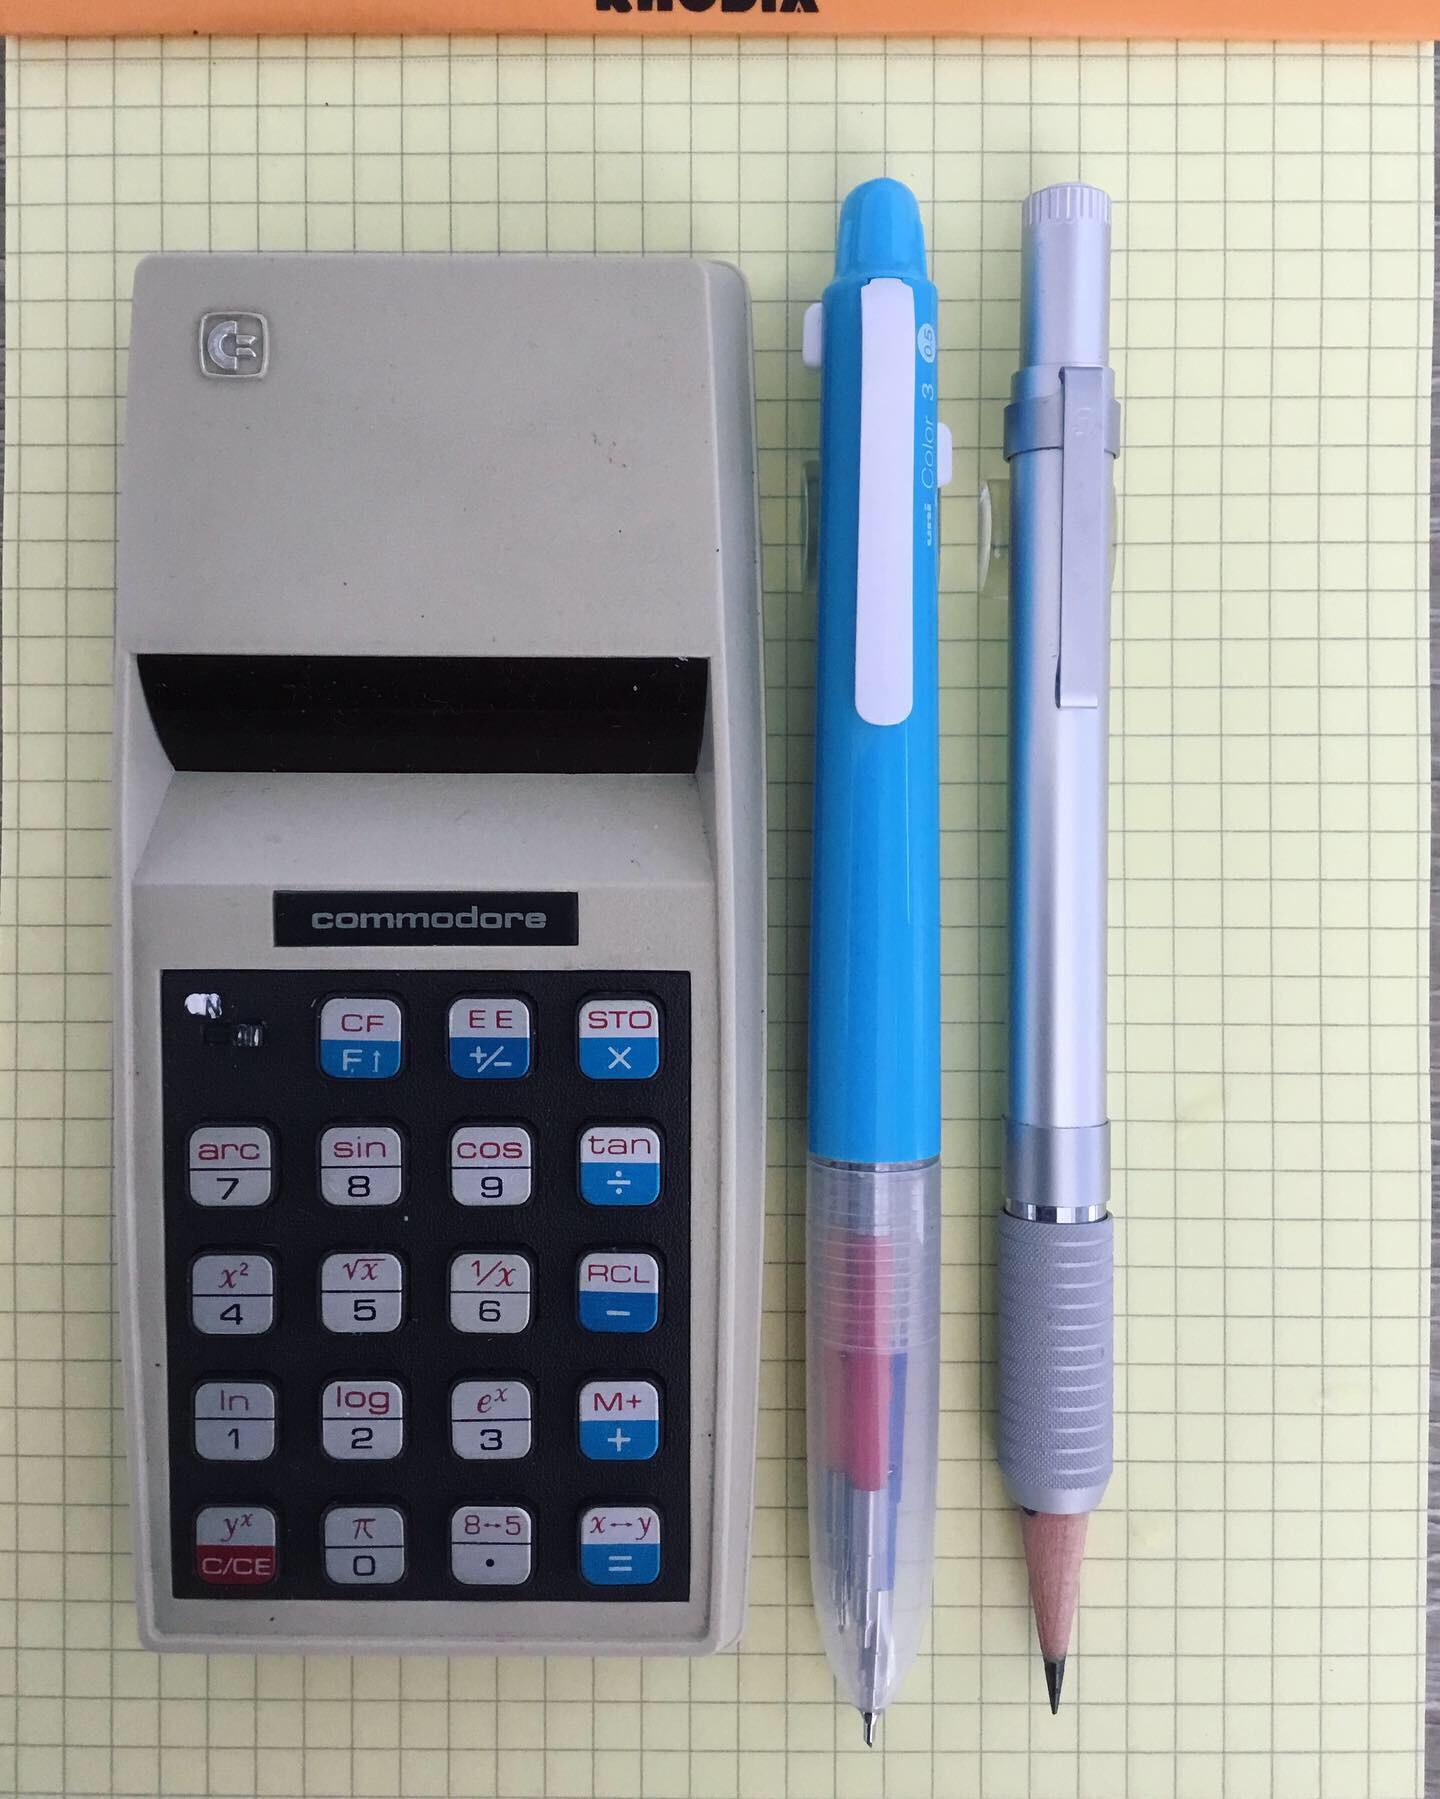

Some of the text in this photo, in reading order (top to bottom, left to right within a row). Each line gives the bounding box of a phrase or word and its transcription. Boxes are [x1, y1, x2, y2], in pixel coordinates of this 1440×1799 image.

[921, 382, 935, 402] 3
[921, 416, 936, 490] Color
[922, 503, 933, 547] uni
[311, 905, 547, 930] commodore
[340, 1013, 385, 1033] CF
[588, 1010, 652, 1030] STO
[198, 1142, 260, 1161] arc
[332, 1136, 388, 1160] sin
[456, 1141, 523, 1159] cos
[587, 1135, 651, 1155] tan
[216, 1177, 240, 1201] 7
[347, 1175, 371, 1198] 8
[480, 1176, 504, 1199] 9
[587, 1264, 650, 1284] RCL
[219, 1303, 244, 1326] 4
[353, 1298, 377, 1322] 5
[478, 1299, 502, 1323] 6
[336, 1385, 390, 1416] log
[593, 1392, 642, 1412] M+
[227, 1428, 240, 1450] 1
[351, 1427, 374, 1450] 2
[479, 1428, 503, 1451] 3
[202, 1557, 271, 1576] C/CE
